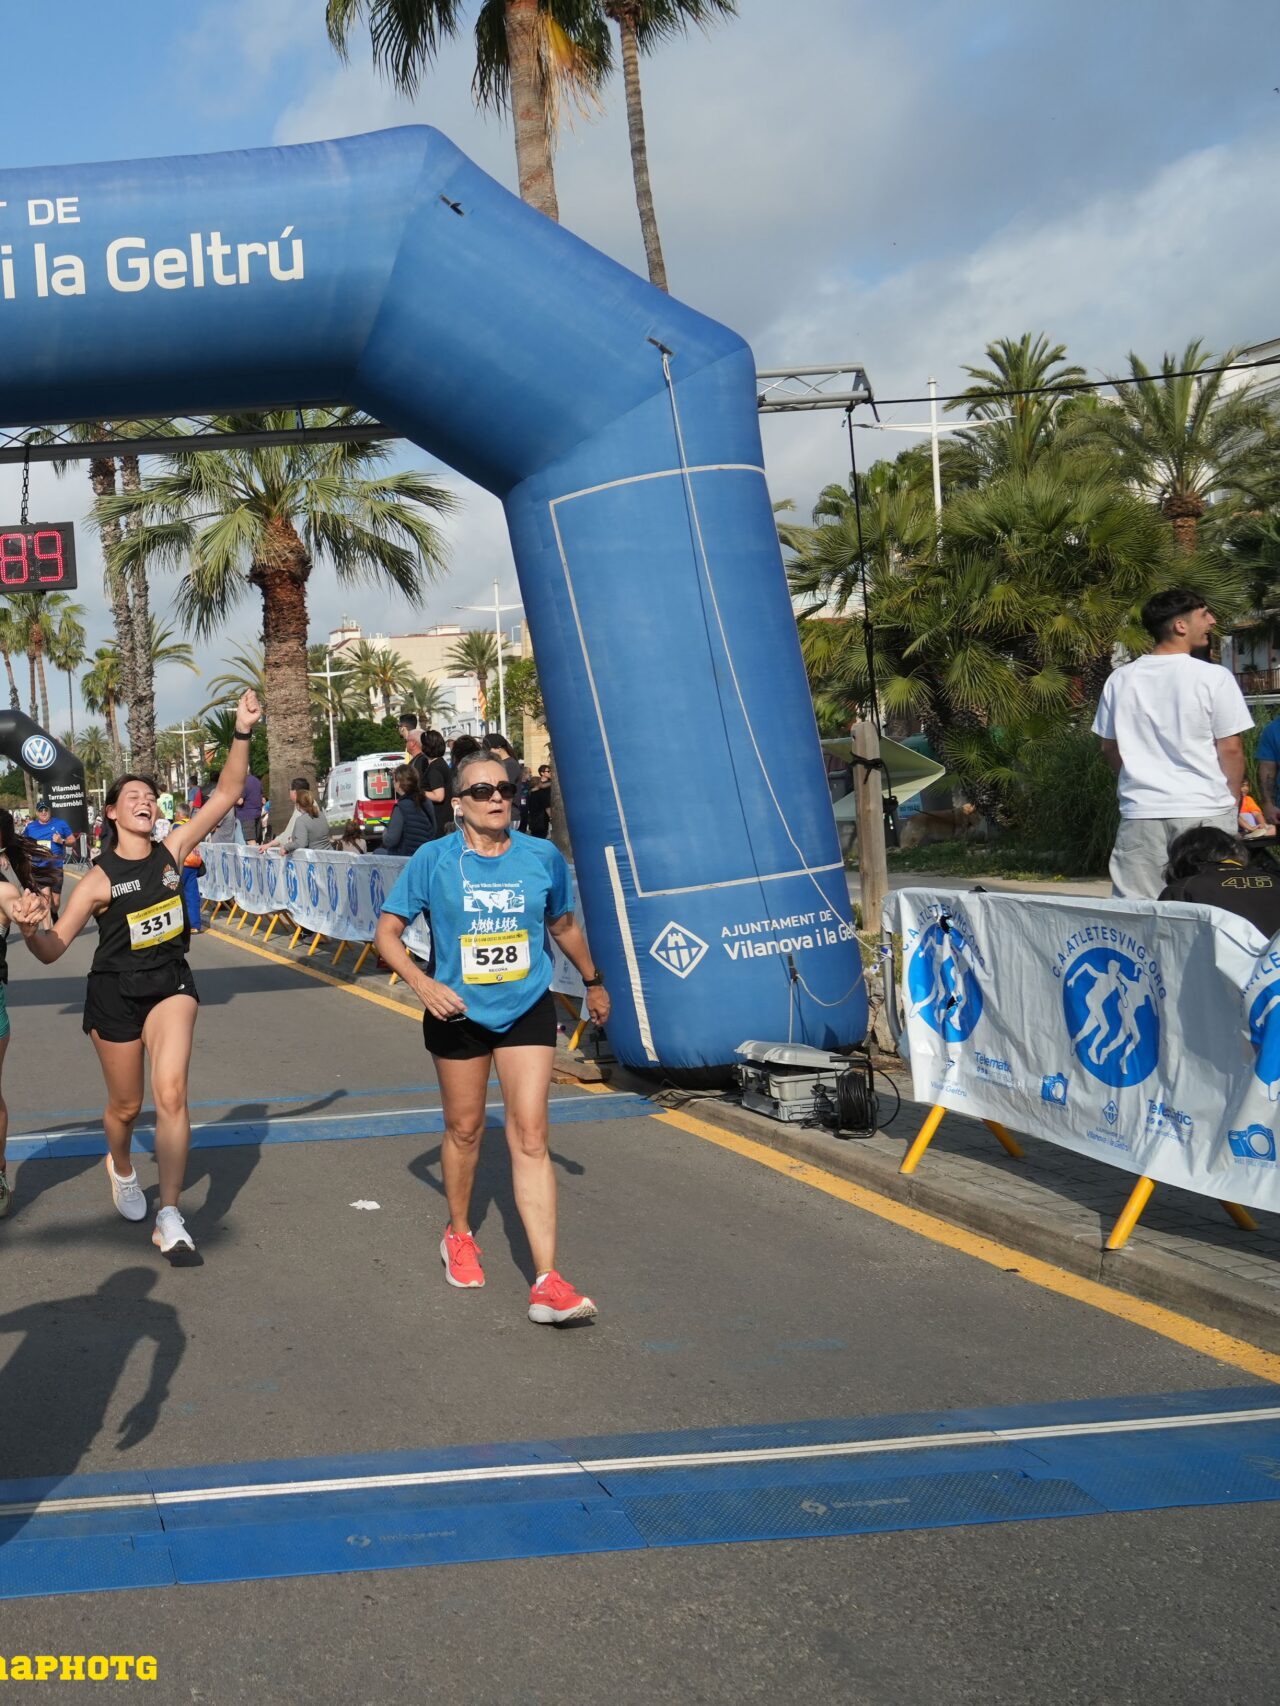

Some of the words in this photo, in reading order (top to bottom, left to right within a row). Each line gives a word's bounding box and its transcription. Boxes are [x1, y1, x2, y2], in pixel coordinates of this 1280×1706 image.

[27, 197, 81, 226] DE
[0, 244, 16, 299] i
[33, 242, 87, 298] la
[105, 225, 305, 293] Geltrú
[1221, 875, 1273, 889] 46
[140, 911, 172, 936] 331
[721, 913, 816, 939] AJUNTAMENT
[818, 909, 833, 923] DE
[475, 944, 519, 966] 528
[722, 934, 814, 961] Vilanova
[814, 929, 822, 947] i
[823, 927, 838, 946] la
